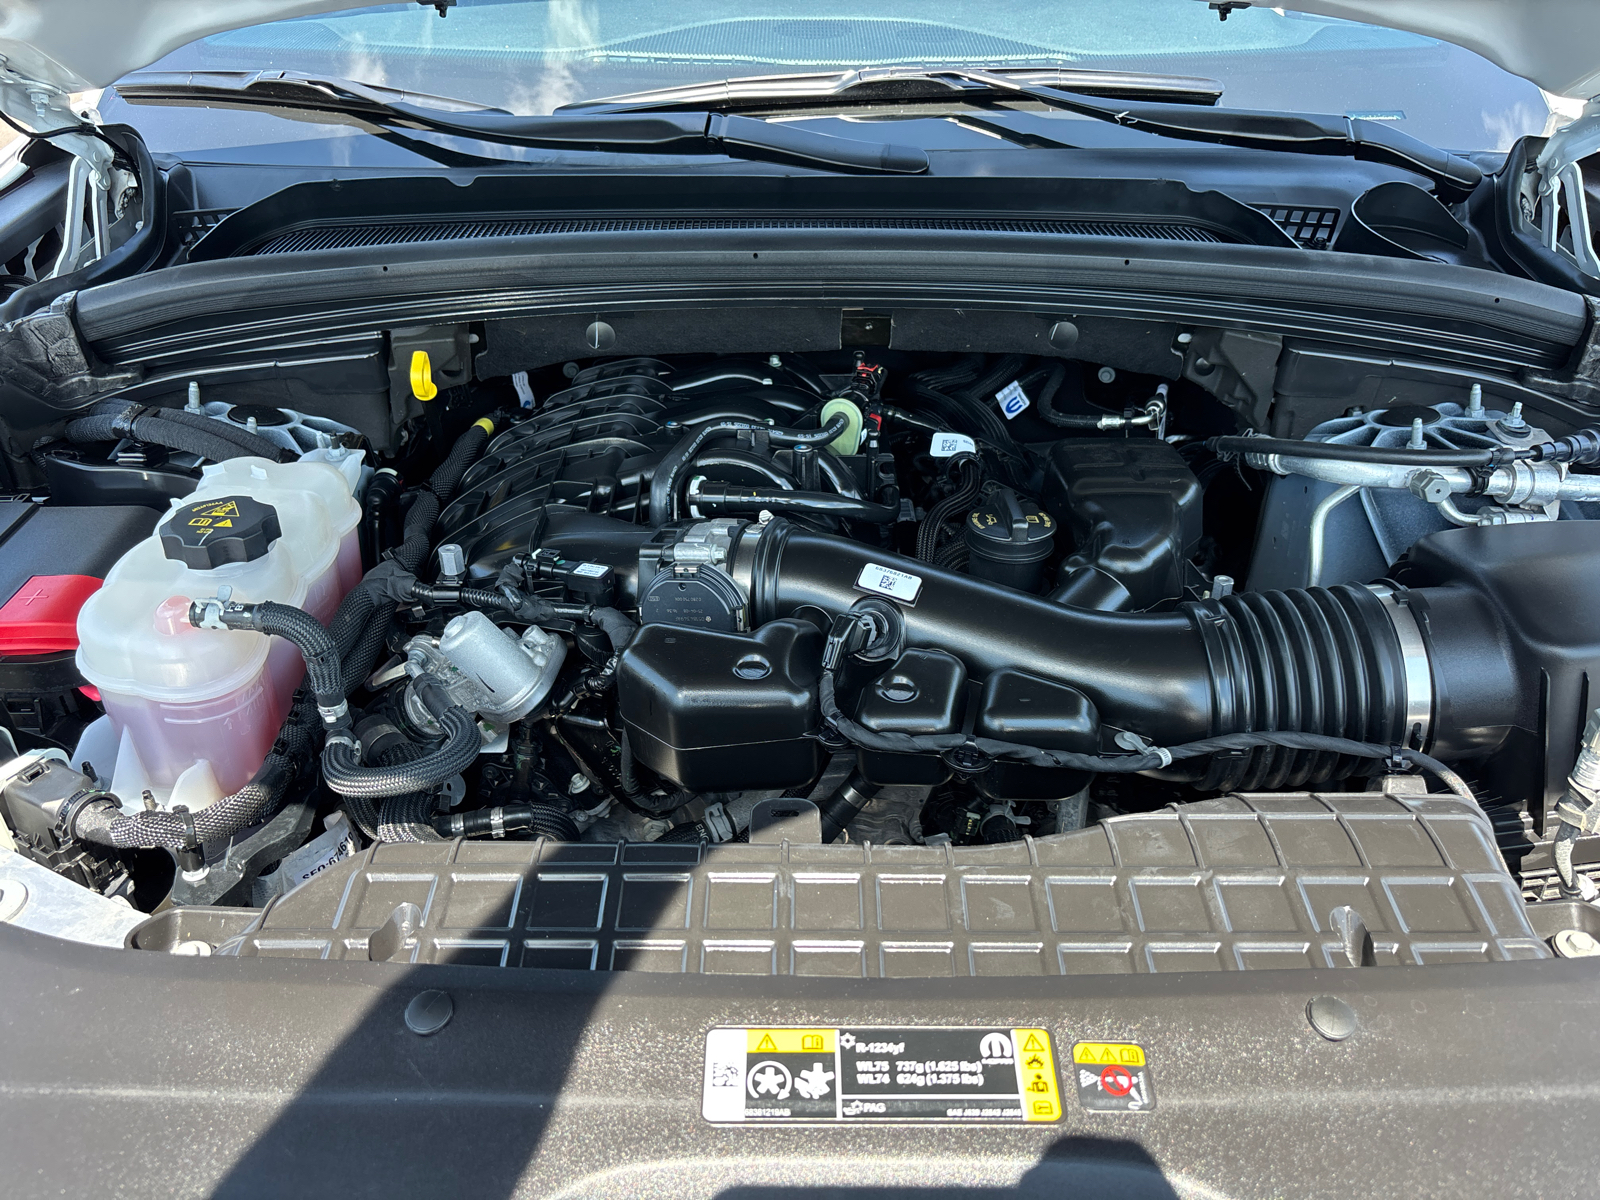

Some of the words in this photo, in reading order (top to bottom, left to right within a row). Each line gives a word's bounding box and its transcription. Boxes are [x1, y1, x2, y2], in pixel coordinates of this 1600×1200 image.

[855, 1042, 905, 1055] R-1234yf
[856, 1061, 890, 1072] WL75
[896, 1061, 924, 1074] 737g
[925, 1061, 959, 1074] (1.625
[960, 1061, 983, 1074] lbs)
[856, 1073, 890, 1084] WL74
[896, 1073, 925, 1087] 624g
[926, 1073, 960, 1087] (1.375
[961, 1073, 984, 1087] lbs)
[863, 1102, 886, 1113] PAG
